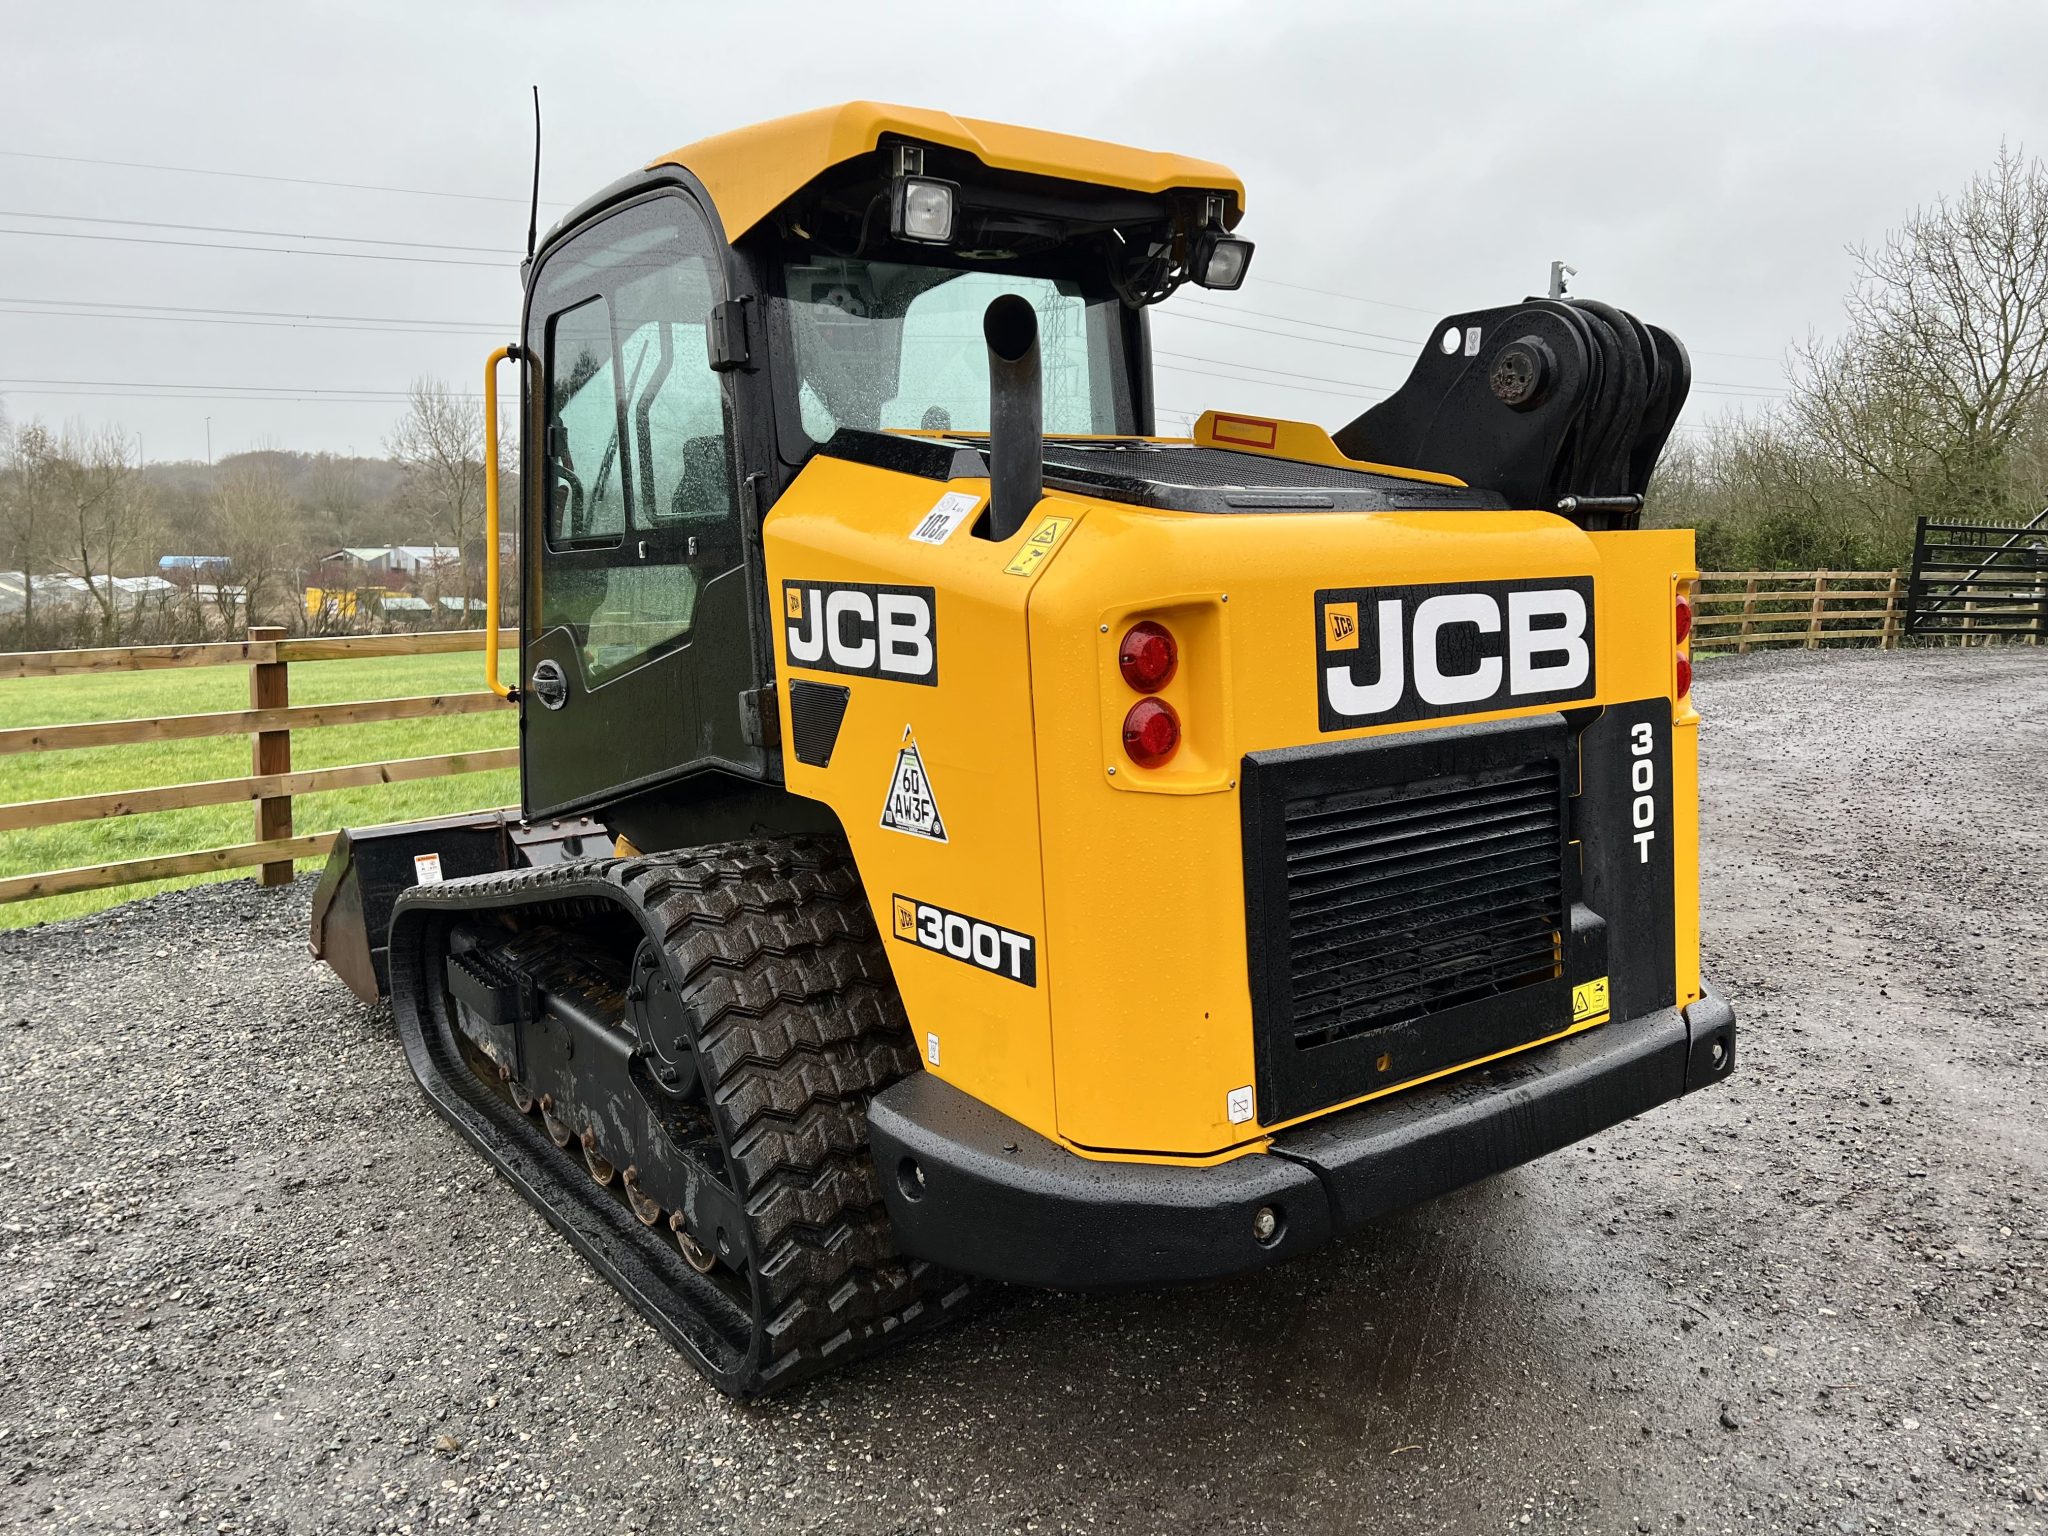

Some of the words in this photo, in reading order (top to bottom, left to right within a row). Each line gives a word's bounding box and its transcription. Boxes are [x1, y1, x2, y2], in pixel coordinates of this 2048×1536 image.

[916, 513, 950, 538] 103
[788, 589, 933, 676] JCB
[1326, 589, 1590, 716] JCB
[1333, 615, 1354, 638] JCB
[895, 794, 930, 824] AW3F
[1631, 722, 1655, 864] 300T
[900, 908, 914, 928] JCB
[917, 905, 1031, 979] 300T
